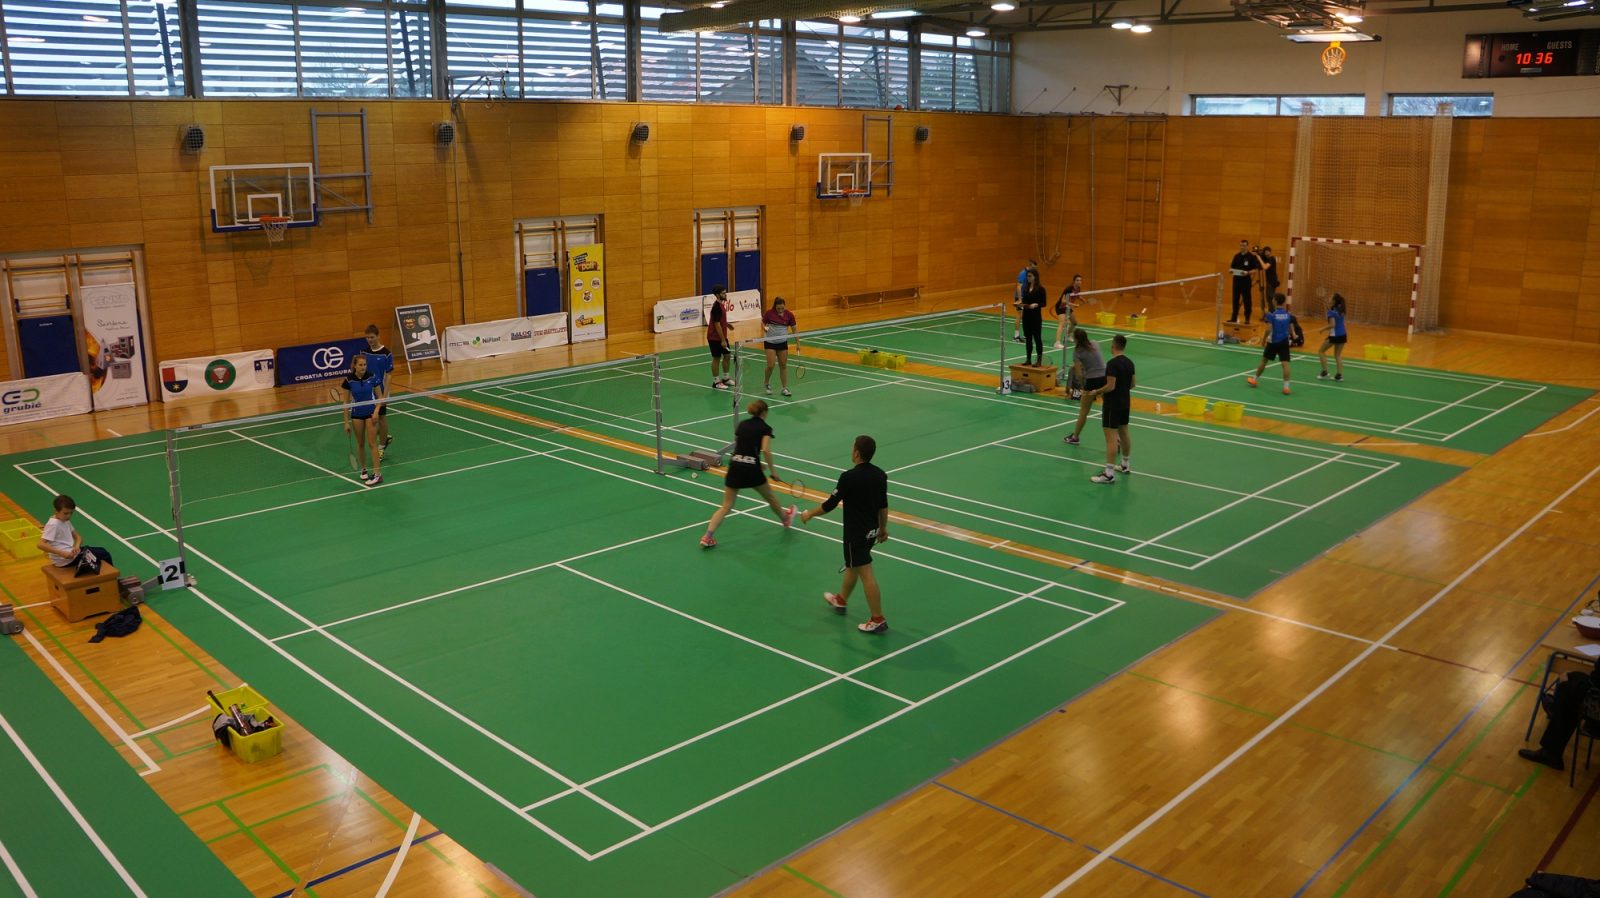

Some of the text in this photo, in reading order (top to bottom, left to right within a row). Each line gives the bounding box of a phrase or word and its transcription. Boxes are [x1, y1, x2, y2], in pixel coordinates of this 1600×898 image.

[1502, 43, 1520, 51] HOME
[1546, 40, 1573, 50] GUESTS
[295, 369, 352, 381] CROATIA OSIGURA
[1004, 379, 1010, 390] 3
[164, 564, 180, 583] 2
